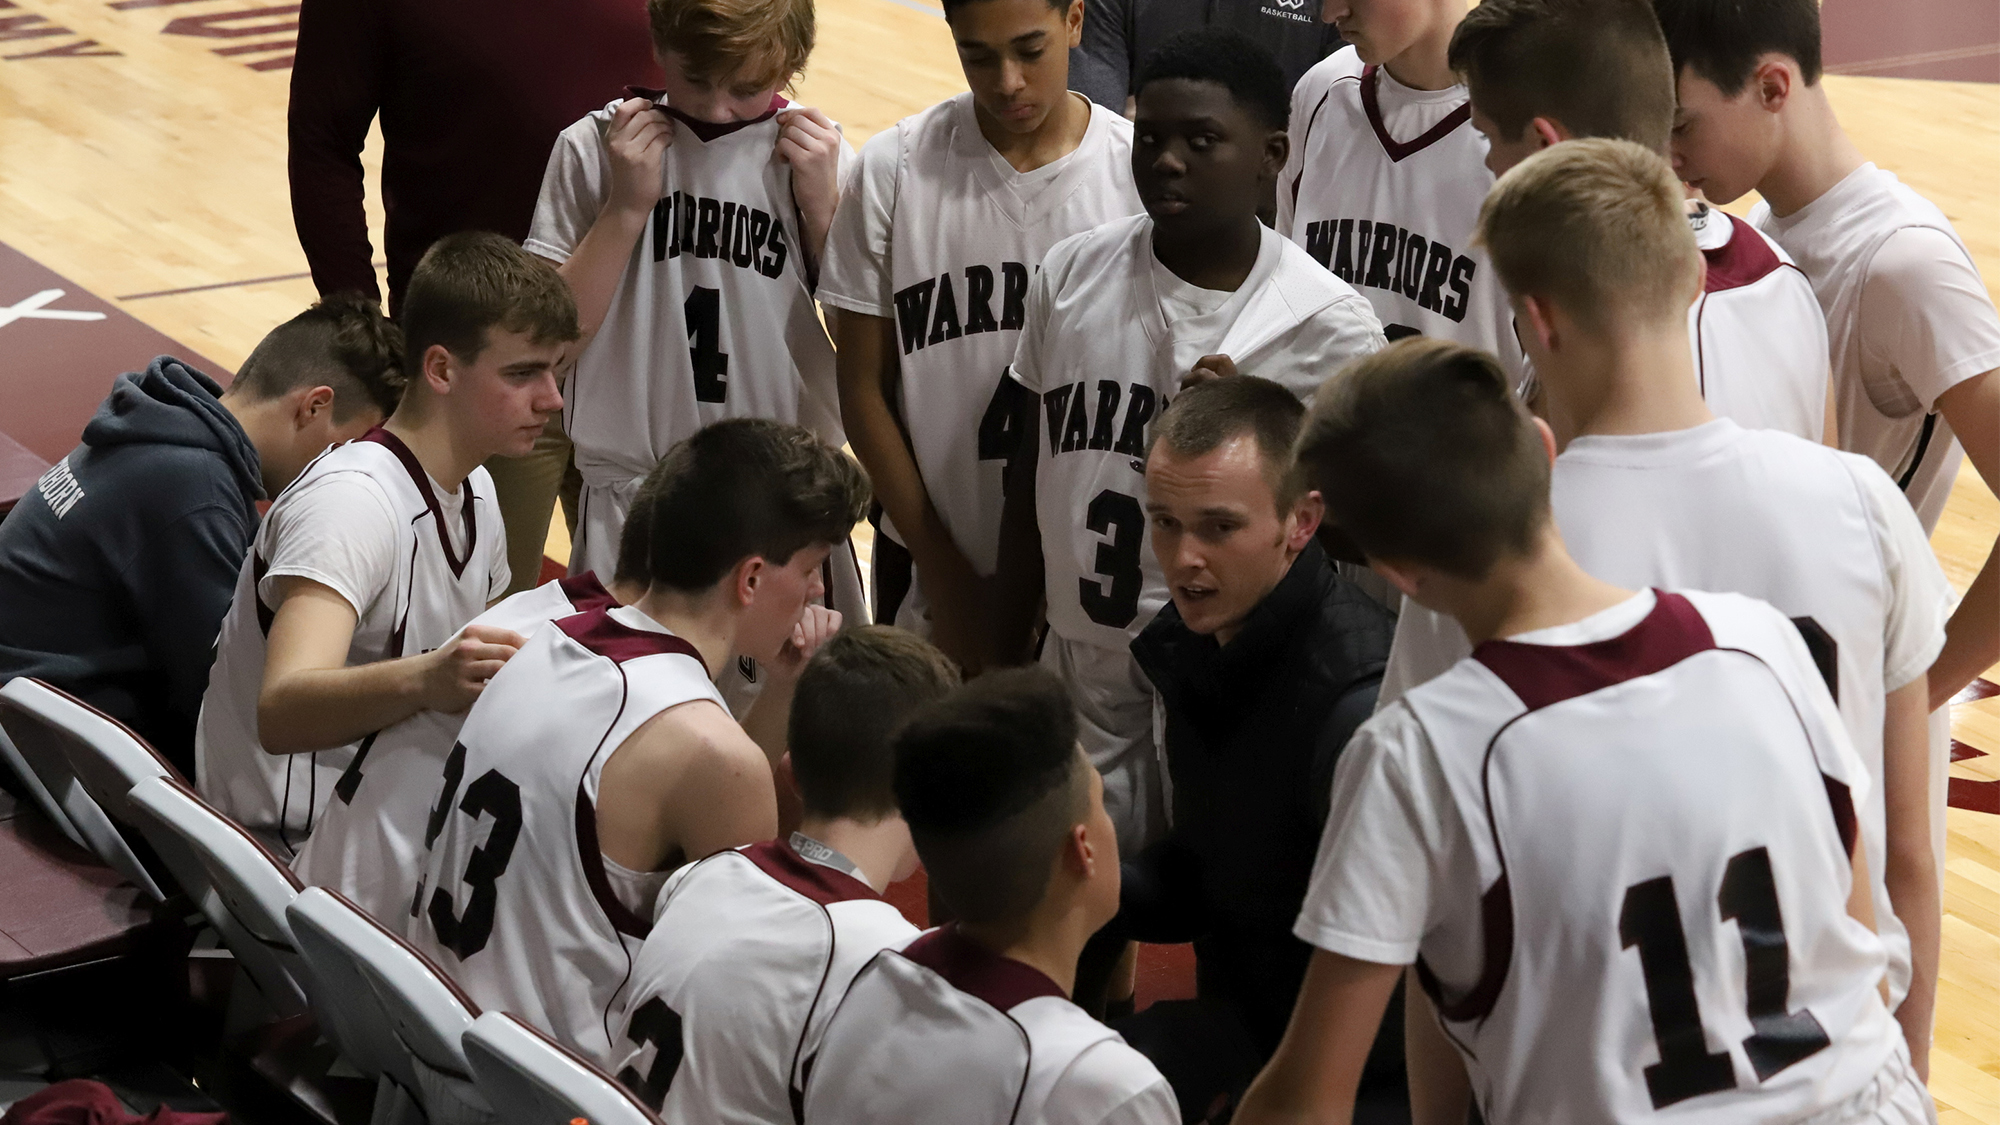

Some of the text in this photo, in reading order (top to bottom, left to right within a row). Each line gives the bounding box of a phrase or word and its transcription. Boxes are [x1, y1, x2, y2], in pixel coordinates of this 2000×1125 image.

[1260, 6, 1312, 23] BASKETBALL
[894, 262, 1040, 355] WARR
[1306, 219, 1476, 323] WARRIORS
[684, 284, 728, 403] 4
[1043, 380, 1169, 458] WARR
[1079, 489, 1145, 629] 3
[1618, 846, 1832, 1111] 11
